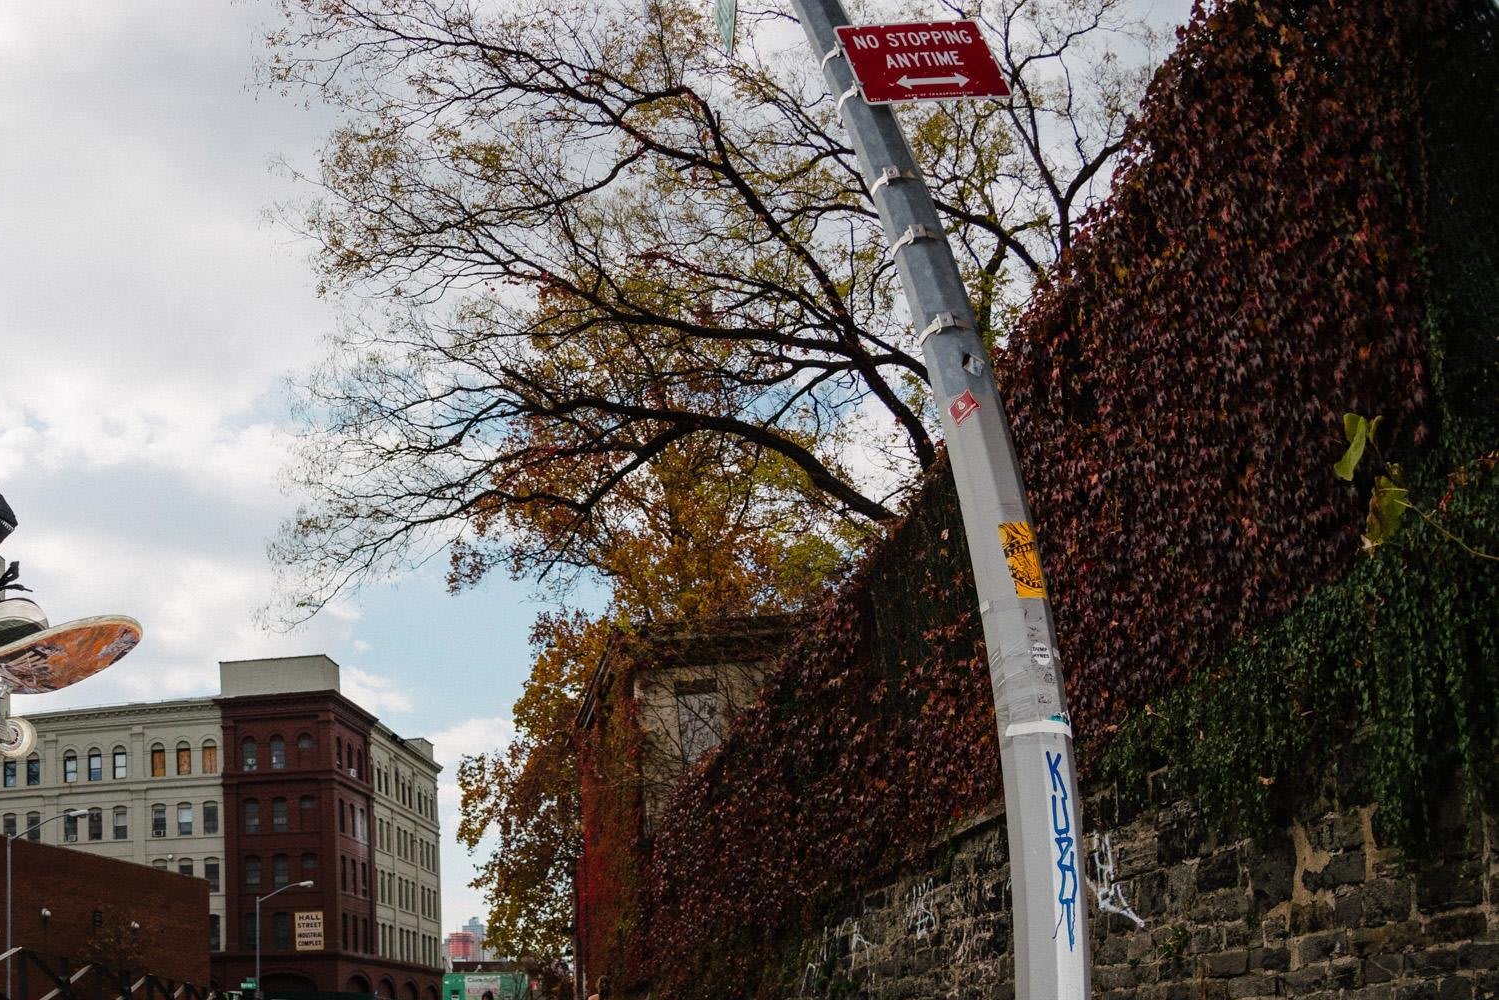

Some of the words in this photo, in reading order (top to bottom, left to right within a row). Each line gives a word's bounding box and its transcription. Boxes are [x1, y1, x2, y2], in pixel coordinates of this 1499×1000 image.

[852, 34, 879, 50] NO
[886, 29, 973, 48] STOPPING
[886, 50, 964, 69] ANYTIME
